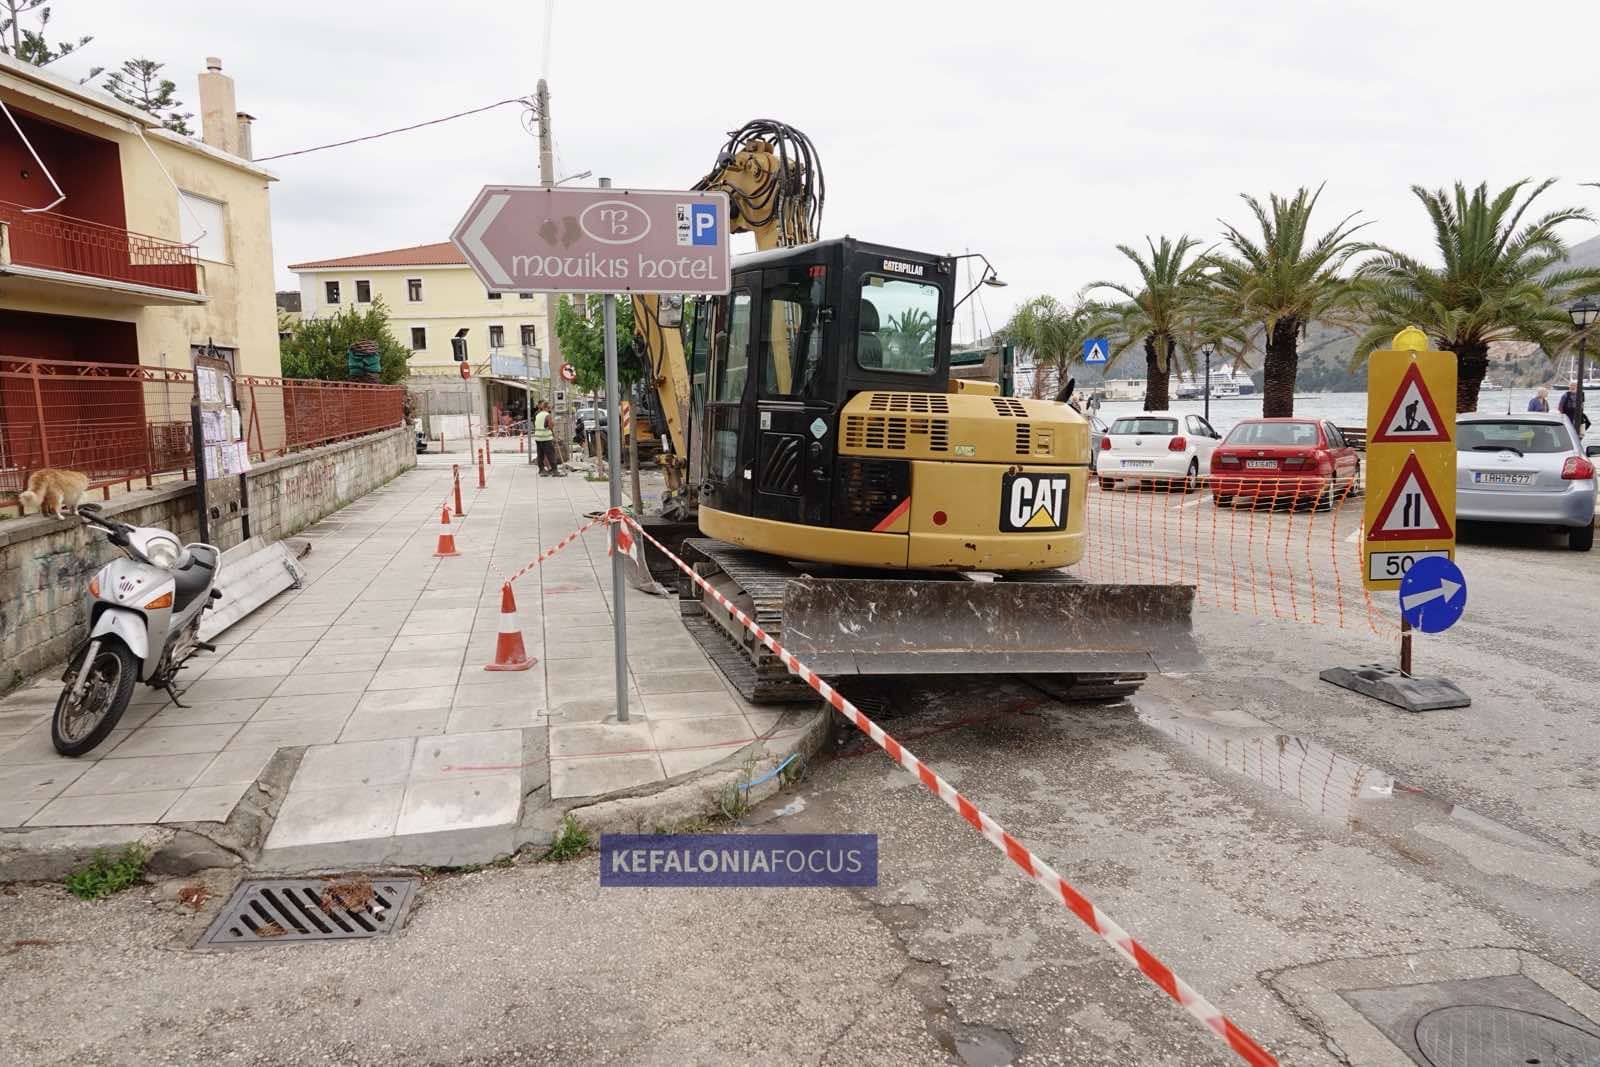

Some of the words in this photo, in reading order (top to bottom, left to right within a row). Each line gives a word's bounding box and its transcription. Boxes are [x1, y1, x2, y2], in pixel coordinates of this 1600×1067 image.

[696, 212, 715, 237] P
[512, 252, 629, 279] mouikis
[638, 254, 718, 280] hotel
[883, 259, 924, 276] CATERPILLAR
[1010, 477, 1067, 528] CAT
